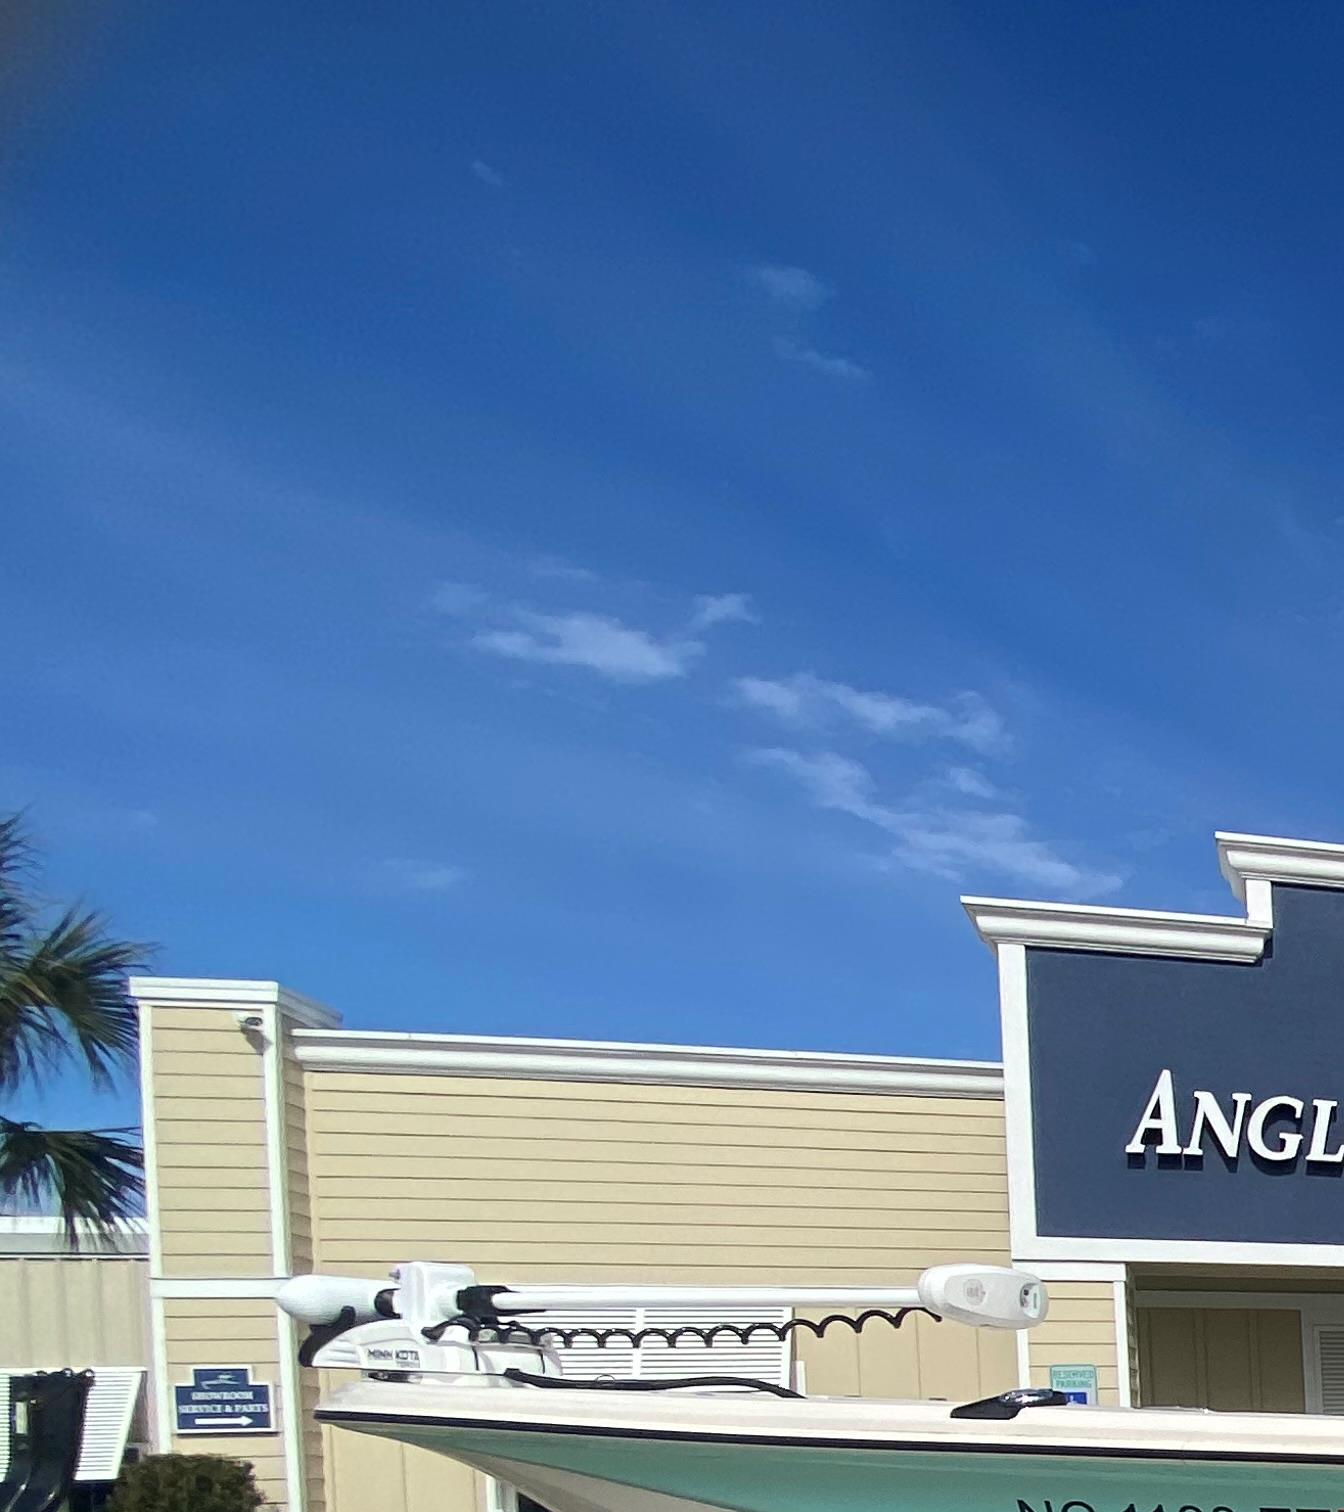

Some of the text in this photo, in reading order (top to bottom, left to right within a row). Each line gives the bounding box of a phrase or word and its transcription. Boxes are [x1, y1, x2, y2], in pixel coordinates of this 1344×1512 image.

[1052, 1370, 1094, 1379] RESERVED
[1055, 1380, 1092, 1388] PARKING
[191, 1391, 254, 1401] SHOWROOM
[178, 1404, 222, 1414] SERVICE
[235, 1403, 269, 1413] PARTS
